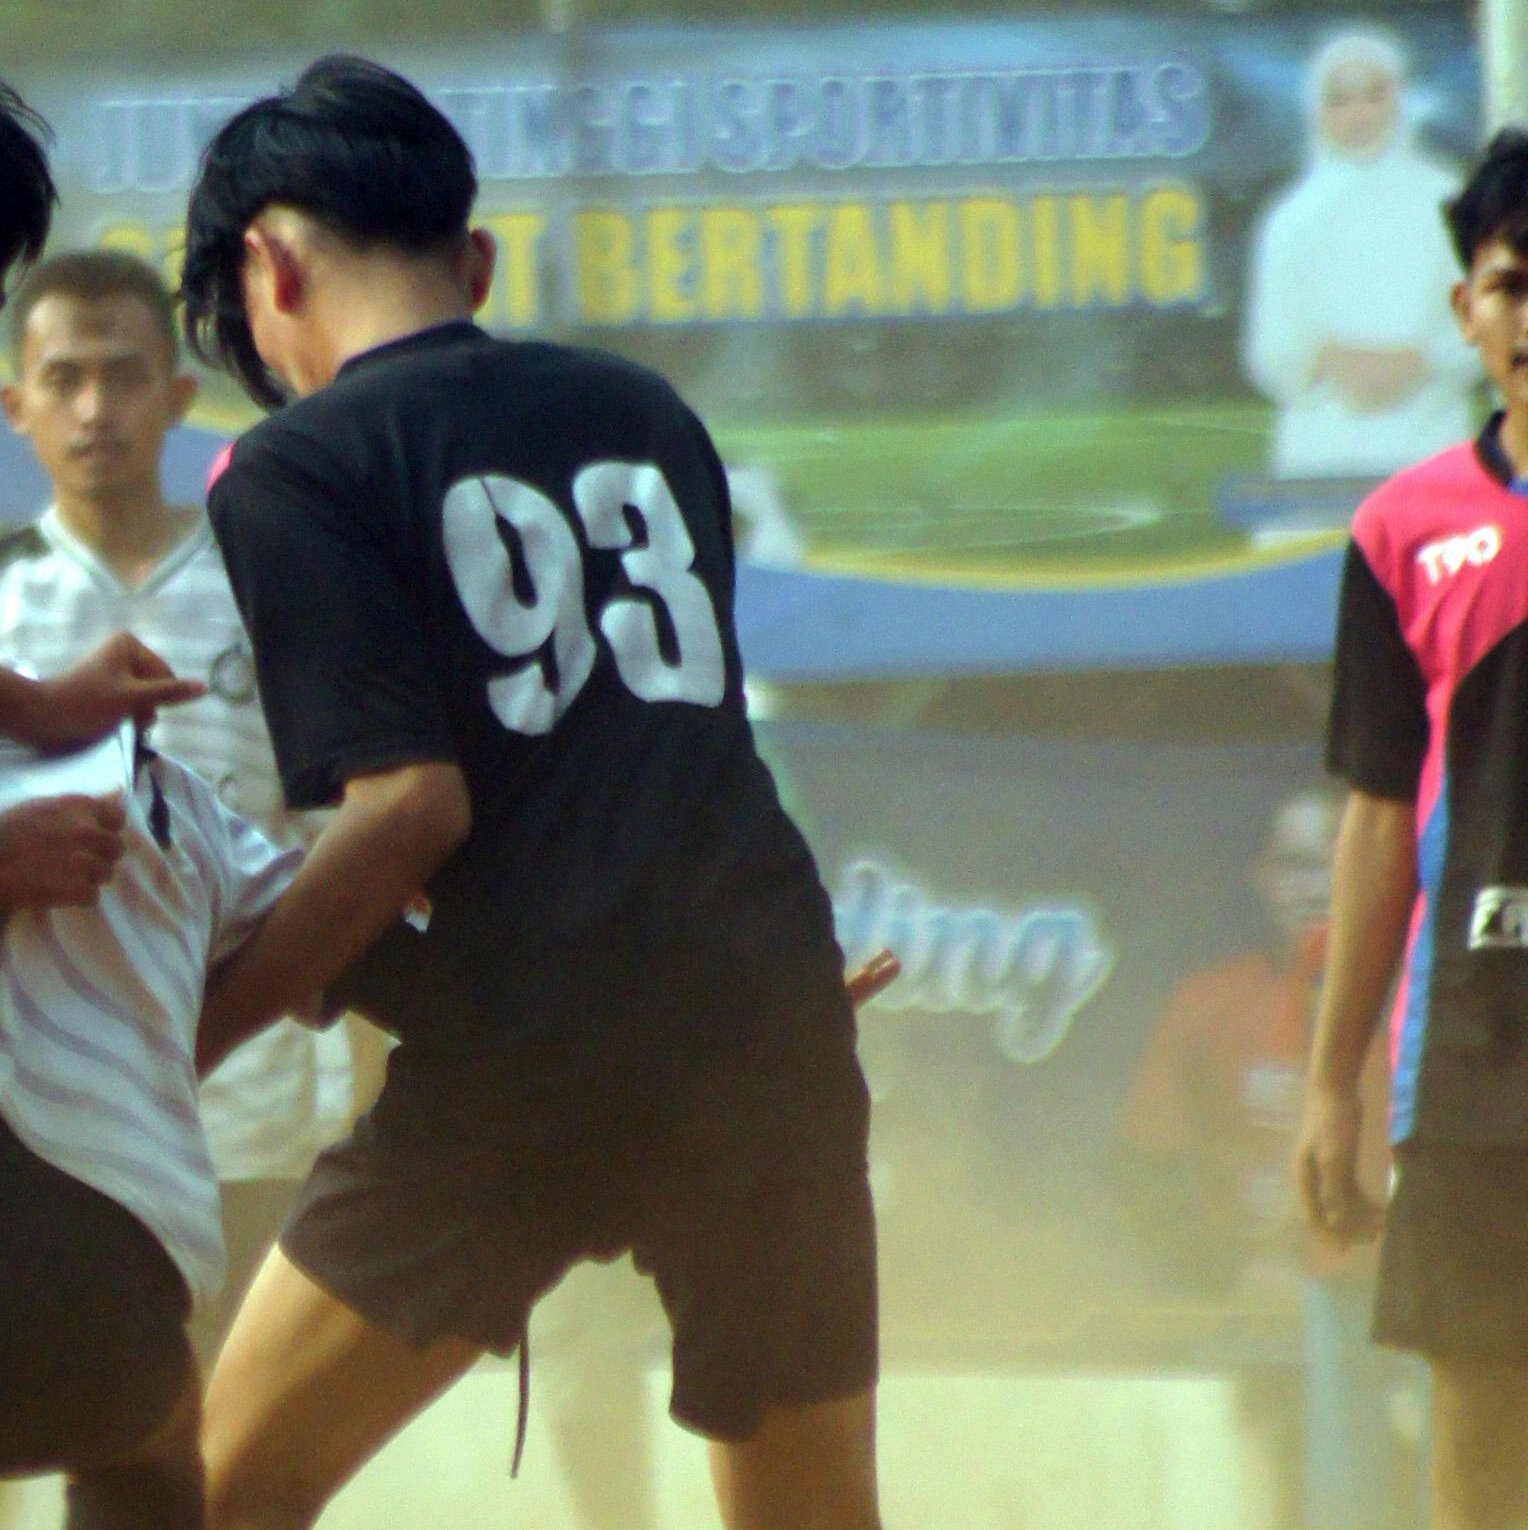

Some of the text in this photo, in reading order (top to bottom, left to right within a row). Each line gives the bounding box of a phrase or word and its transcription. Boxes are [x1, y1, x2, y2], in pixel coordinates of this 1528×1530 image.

[717, 69, 1207, 167] SPORTIVITAS
[575, 186, 1202, 324] BERTANDING
[442, 461, 727, 735] 93
